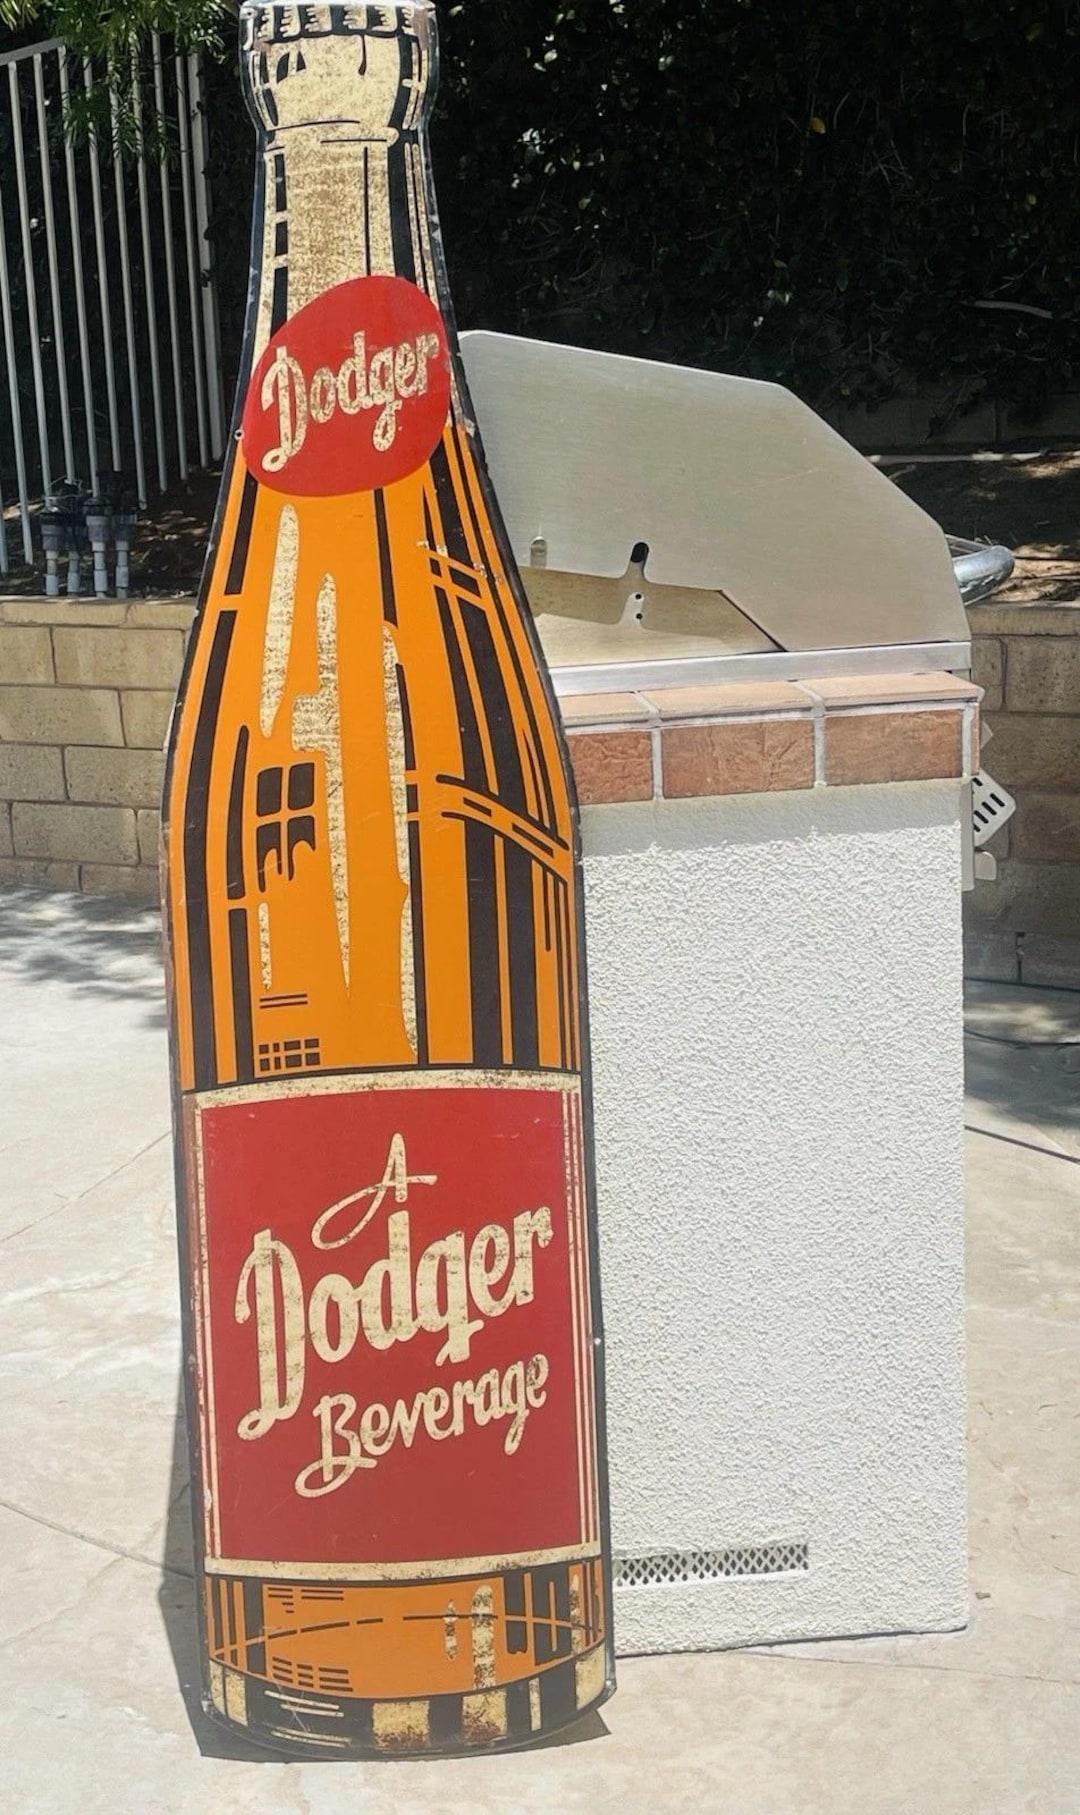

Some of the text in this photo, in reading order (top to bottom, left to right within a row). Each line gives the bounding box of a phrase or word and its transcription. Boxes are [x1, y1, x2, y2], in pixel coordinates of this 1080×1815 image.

[262, 331, 440, 472] Dodger
[312, 1133, 438, 1249] A
[235, 1207, 554, 1440] Dodger
[295, 1354, 549, 1497] Beverage
